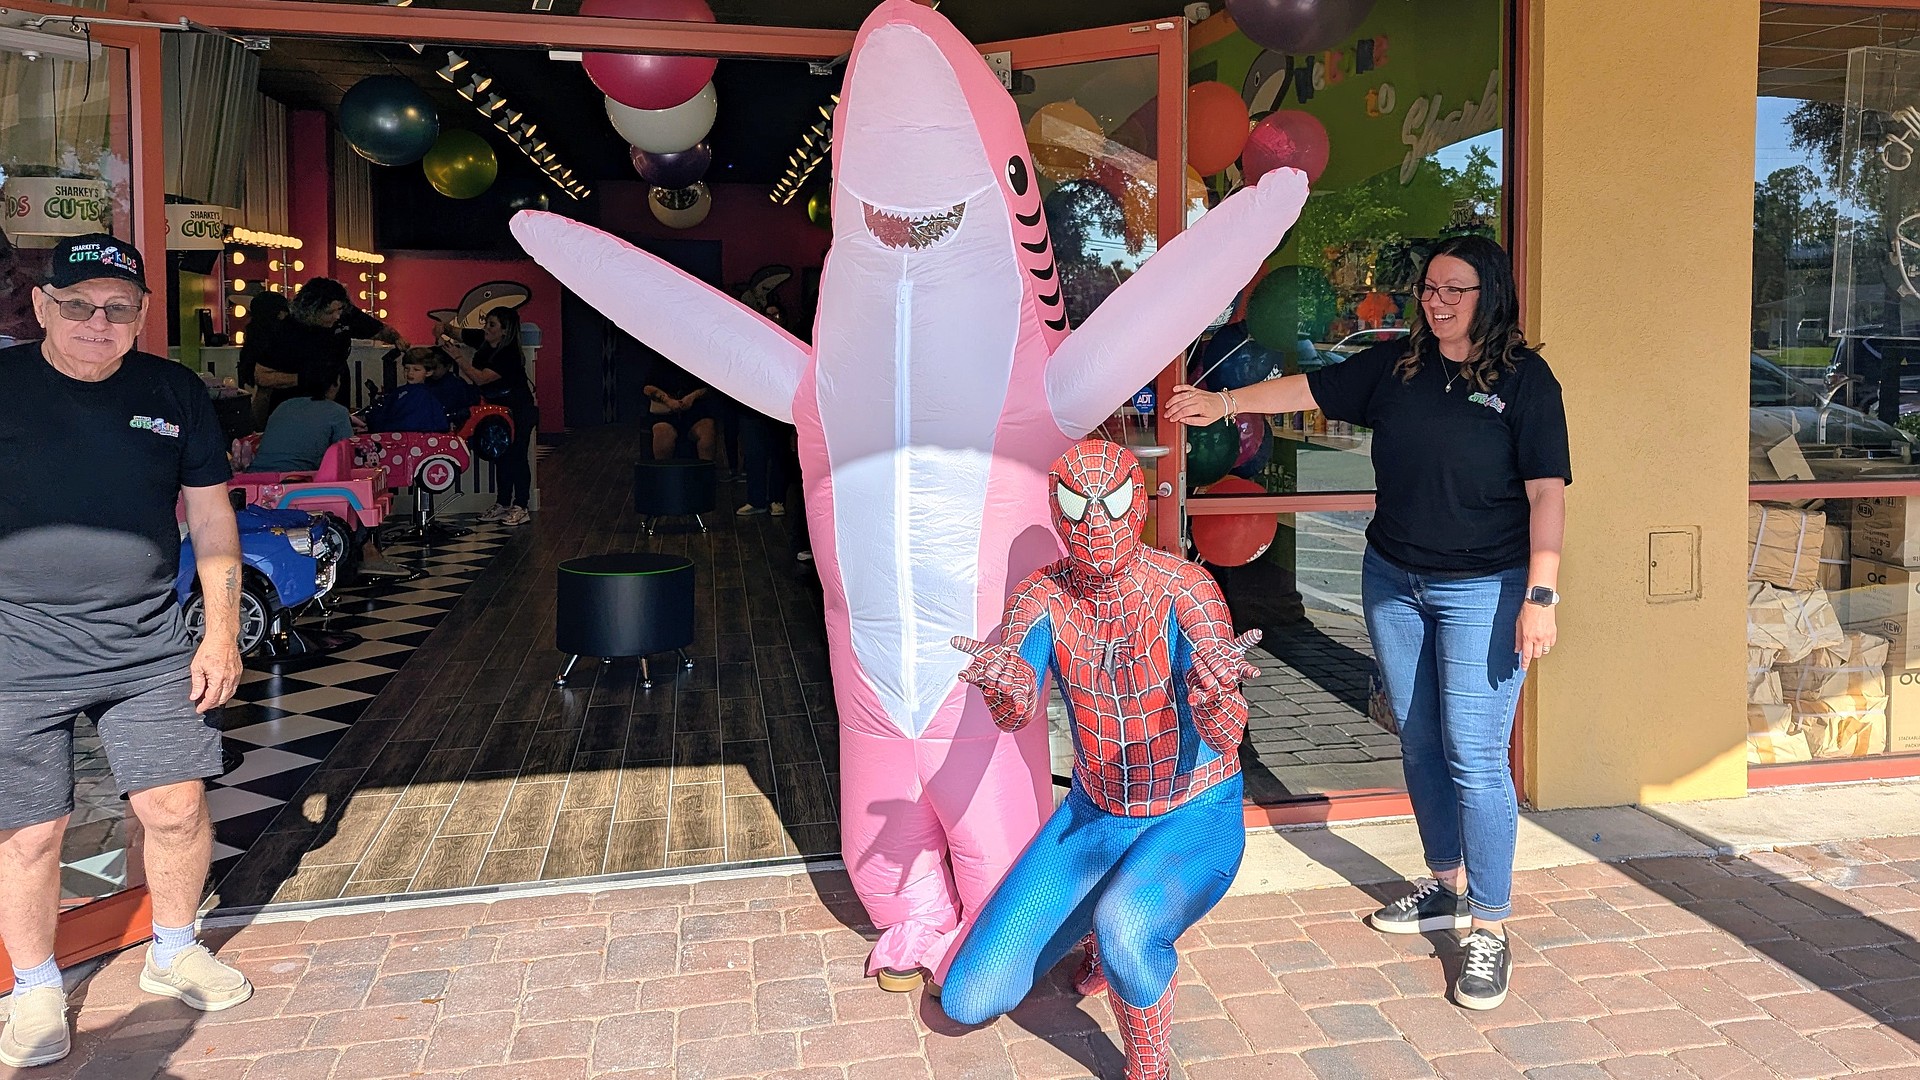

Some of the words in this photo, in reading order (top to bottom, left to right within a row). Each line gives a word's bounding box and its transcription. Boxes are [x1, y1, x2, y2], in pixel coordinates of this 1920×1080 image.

[1365, 82, 1396, 118] to
[55, 185, 99, 198] SHARKEY'S
[44, 197, 99, 221] CUTS
[181, 220, 221, 239] CUTS
[69, 251, 100, 263] CUTS
[114, 251, 137, 269] KIDS
[1136, 394, 1153, 404] ADT
[1867, 572, 1887, 585] OC
[1883, 621, 1900, 633] NEW
